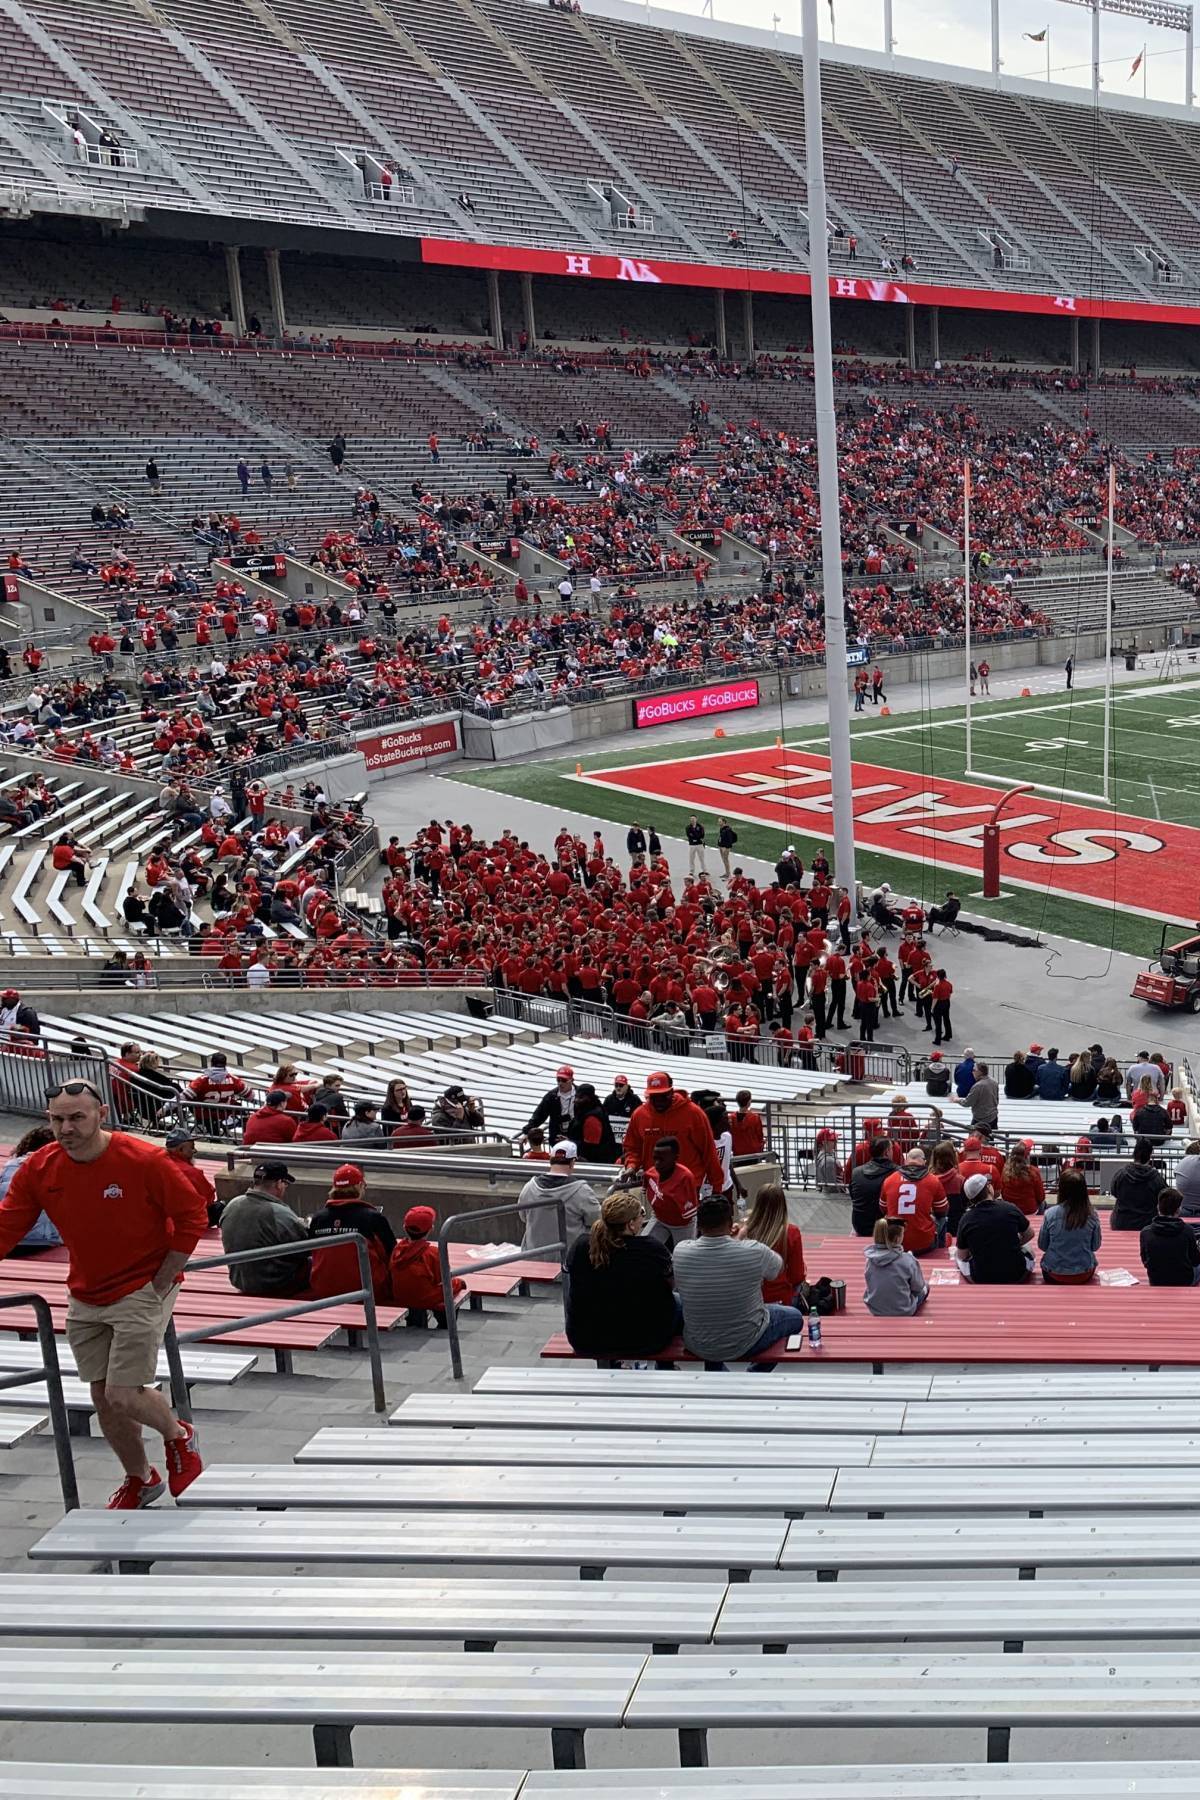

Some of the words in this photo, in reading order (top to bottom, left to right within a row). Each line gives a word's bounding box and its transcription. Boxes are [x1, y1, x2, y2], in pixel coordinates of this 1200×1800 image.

[565, 255, 591, 275] H
[836, 278, 856, 297] H
[381, 732, 422, 750] #GoBucks
[681, 764, 1166, 865] STATE
[897, 1183, 917, 1215] 2
[728, 1668, 739, 1678] 6
[920, 1667, 929, 1677] 7
[1108, 1667, 1117, 1676] 8
